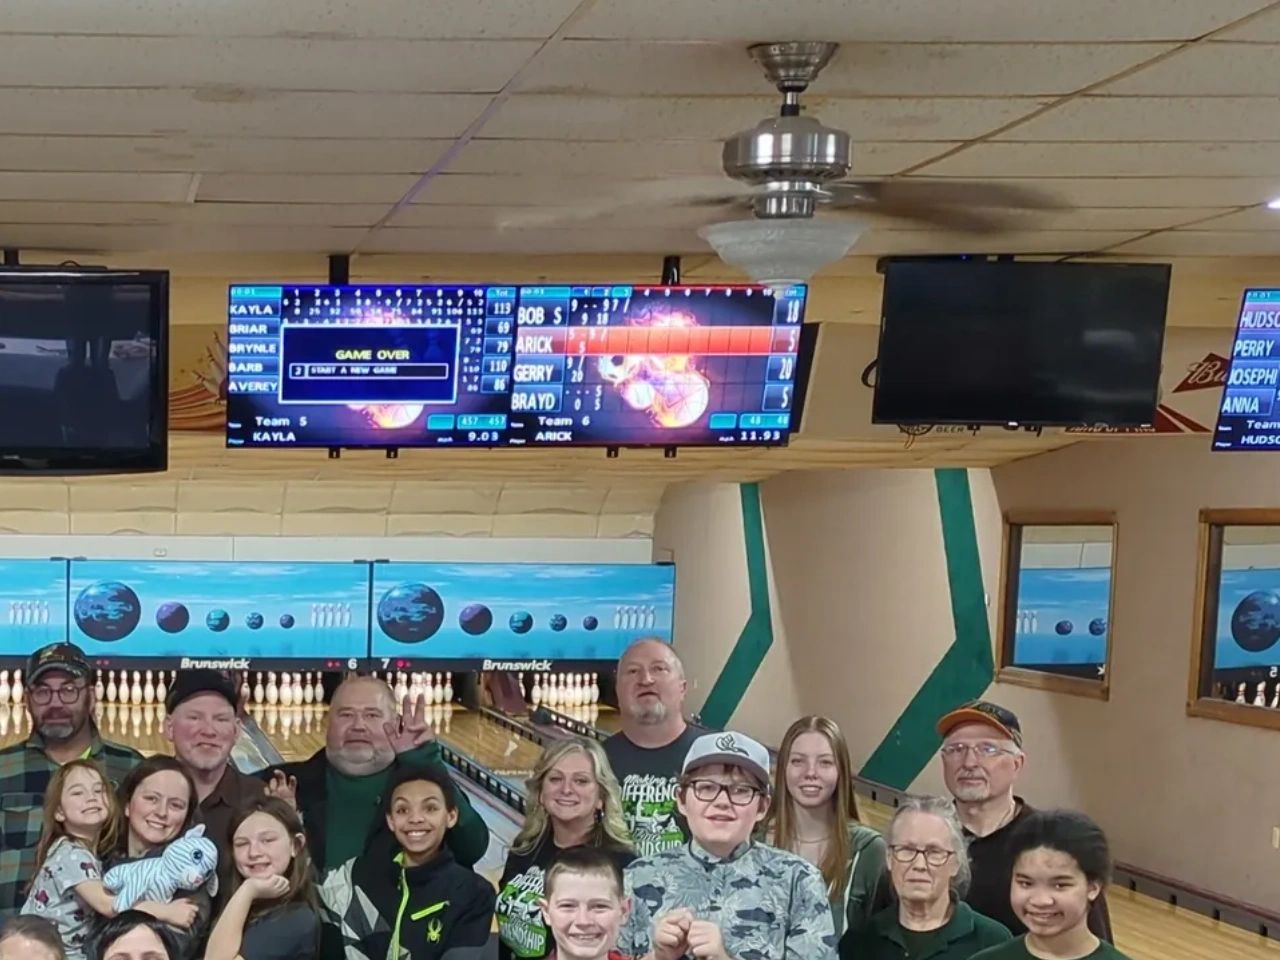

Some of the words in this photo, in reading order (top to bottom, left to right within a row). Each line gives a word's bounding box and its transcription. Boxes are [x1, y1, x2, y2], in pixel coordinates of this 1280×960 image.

[230, 304, 273, 316] KAYLA
[494, 302, 512, 315] 113
[518, 306, 545, 325] BOB
[553, 306, 562, 325] S
[786, 299, 800, 323] 18
[229, 324, 268, 335] BRIAR
[497, 321, 510, 334] 69
[229, 343, 276, 354] BRYNLE
[496, 341, 509, 354] 79
[515, 336, 554, 354] ARICK
[788, 329, 796, 353] 5
[336, 350, 372, 360] GAME
[377, 350, 410, 360] OVER
[1233, 340, 1275, 358] PERRY
[228, 362, 264, 373] BARB
[490, 360, 508, 373] 110
[514, 364, 554, 383] GERRY
[778, 357, 793, 380] 20
[228, 382, 278, 393] AVEREY
[493, 378, 506, 392] 86
[511, 392, 556, 411] BRAYD
[780, 386, 790, 410] 5
[1222, 396, 1260, 414] ANNA
[256, 416, 290, 427] Team
[299, 416, 308, 427] 5
[538, 416, 574, 427] Team
[582, 416, 590, 426] 6
[252, 432, 296, 442] KAYLA
[468, 431, 499, 442] 9.03
[535, 431, 573, 442] ARICK
[740, 430, 781, 441] 11.93
[181, 658, 250, 670] Brunswick
[348, 658, 358, 668] 6
[381, 658, 391, 668] 7
[482, 660, 552, 672] Brunswick
